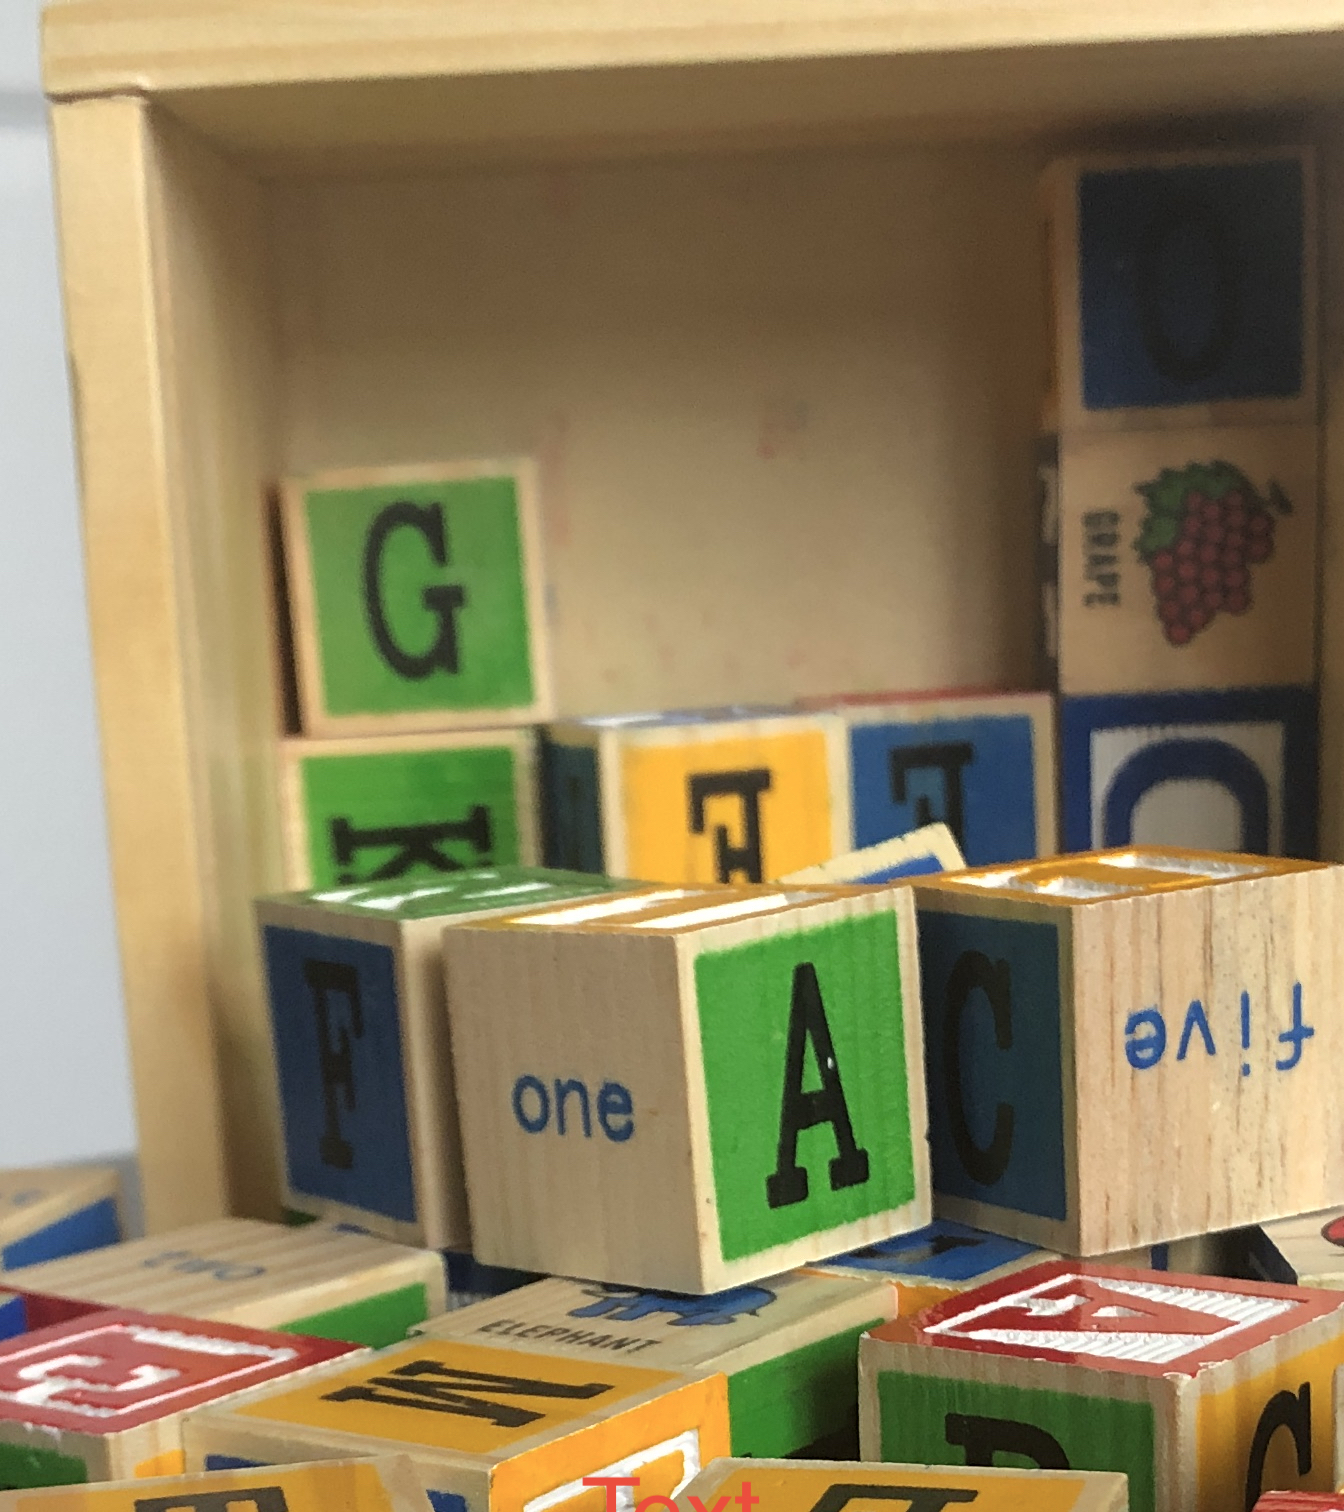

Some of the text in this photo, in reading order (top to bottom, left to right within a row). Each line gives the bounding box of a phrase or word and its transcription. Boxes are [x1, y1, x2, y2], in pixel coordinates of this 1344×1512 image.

[363, 501, 467, 679] G
[303, 957, 364, 1169] F
[943, 950, 1015, 1187] C
[1124, 981, 1315, 1077] five
[512, 1072, 635, 1143] one
[766, 961, 871, 1210] A
[476, 1318, 662, 1353] ELEPHANT
[954, 1277, 1242, 1335] A
[320, 1359, 615, 1428] M
